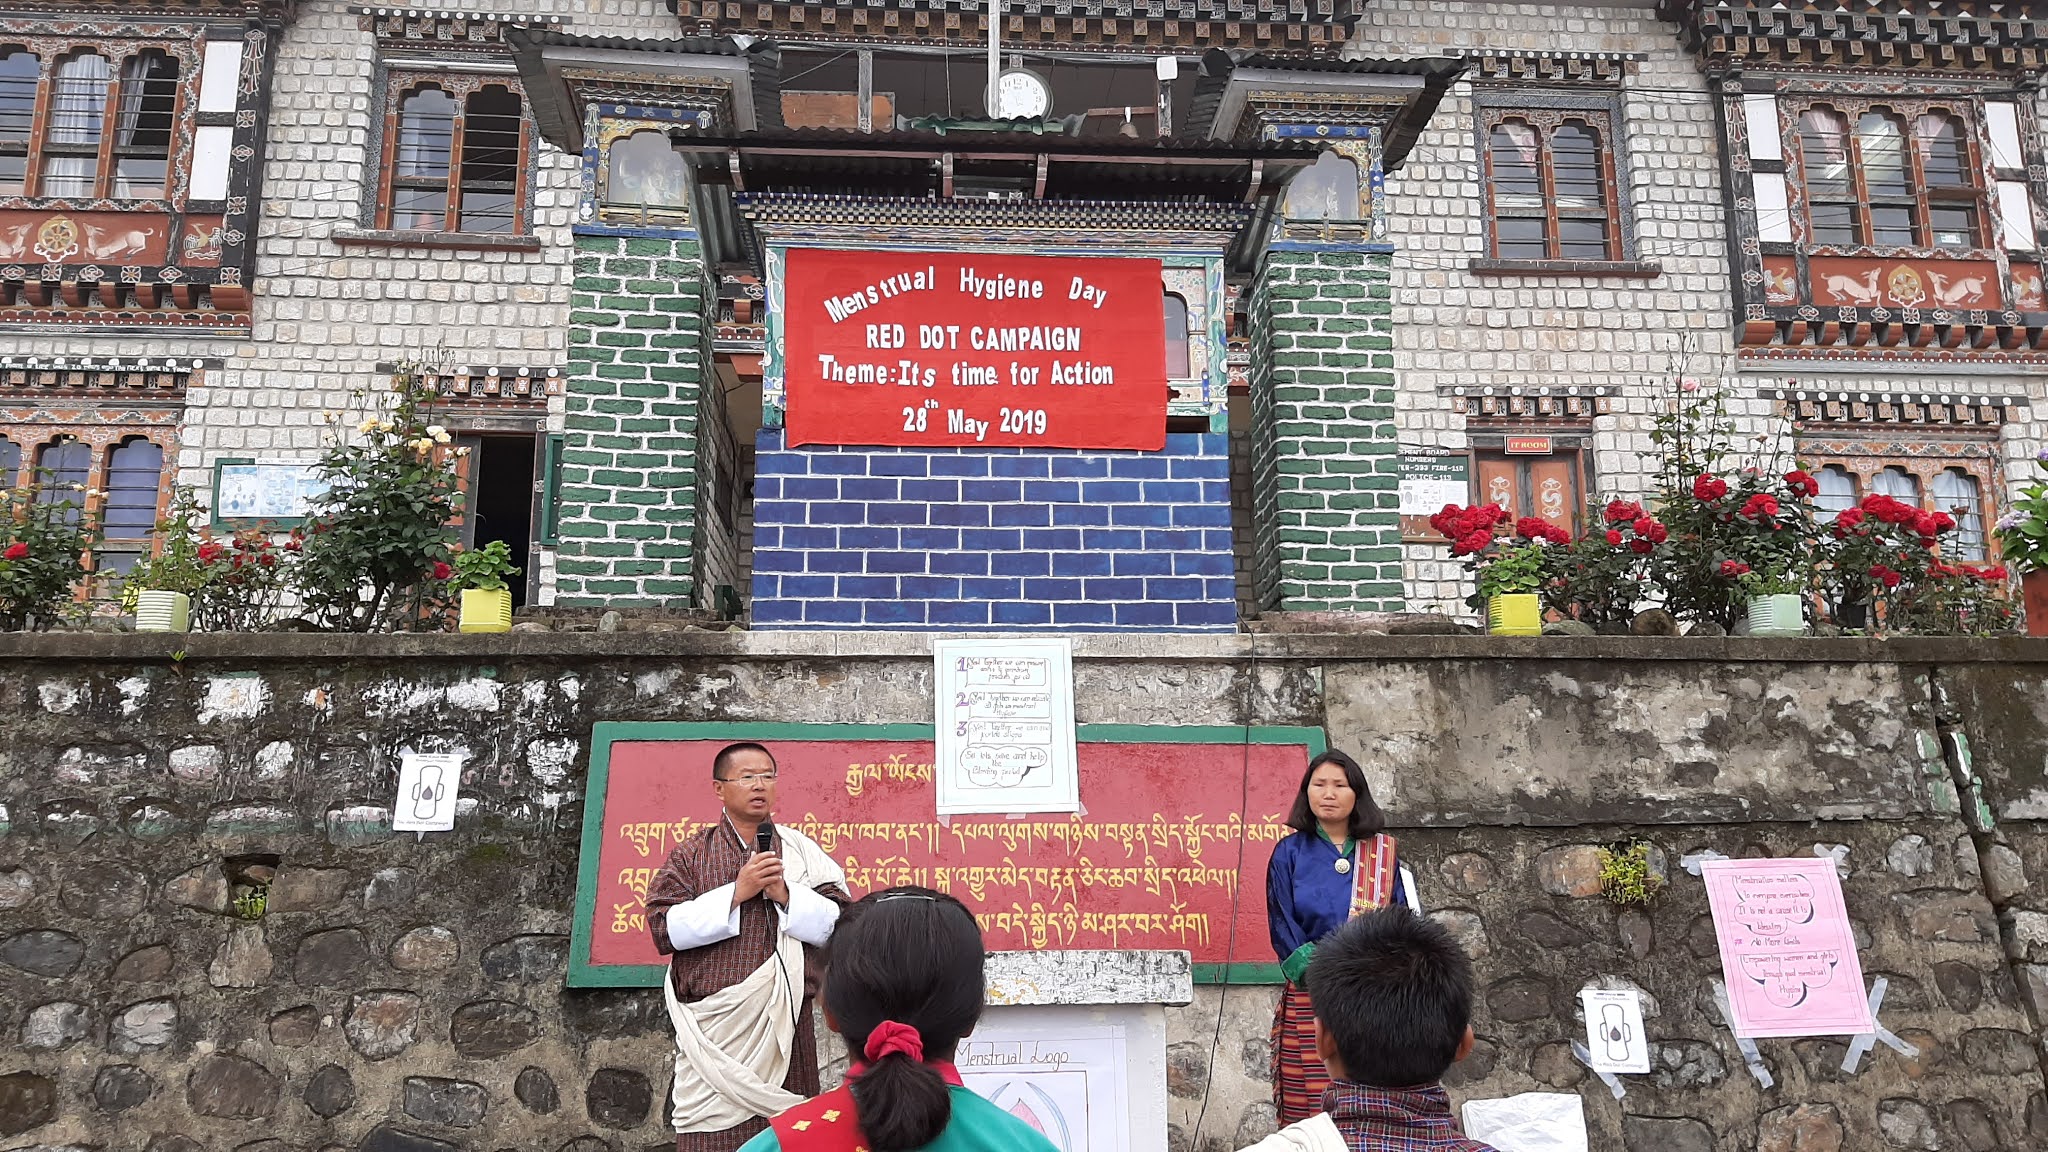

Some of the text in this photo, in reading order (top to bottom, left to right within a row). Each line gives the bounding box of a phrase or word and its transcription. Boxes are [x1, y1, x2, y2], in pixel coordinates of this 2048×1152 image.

[824, 266, 1107, 324] Menstrual Hygiene Day
[866, 324, 1081, 352] RED DOT CAMPAIGN
[952, 362, 998, 386] time
[1010, 362, 1039, 386] for
[1050, 360, 1114, 386] Action
[902, 398, 1047, 442] 28th May 2019
[957, 657, 968, 671] 1
[955, 692, 969, 708] 2
[956, 721, 968, 737] 3
[956, 1041, 1069, 1072] Menstrual Logo
